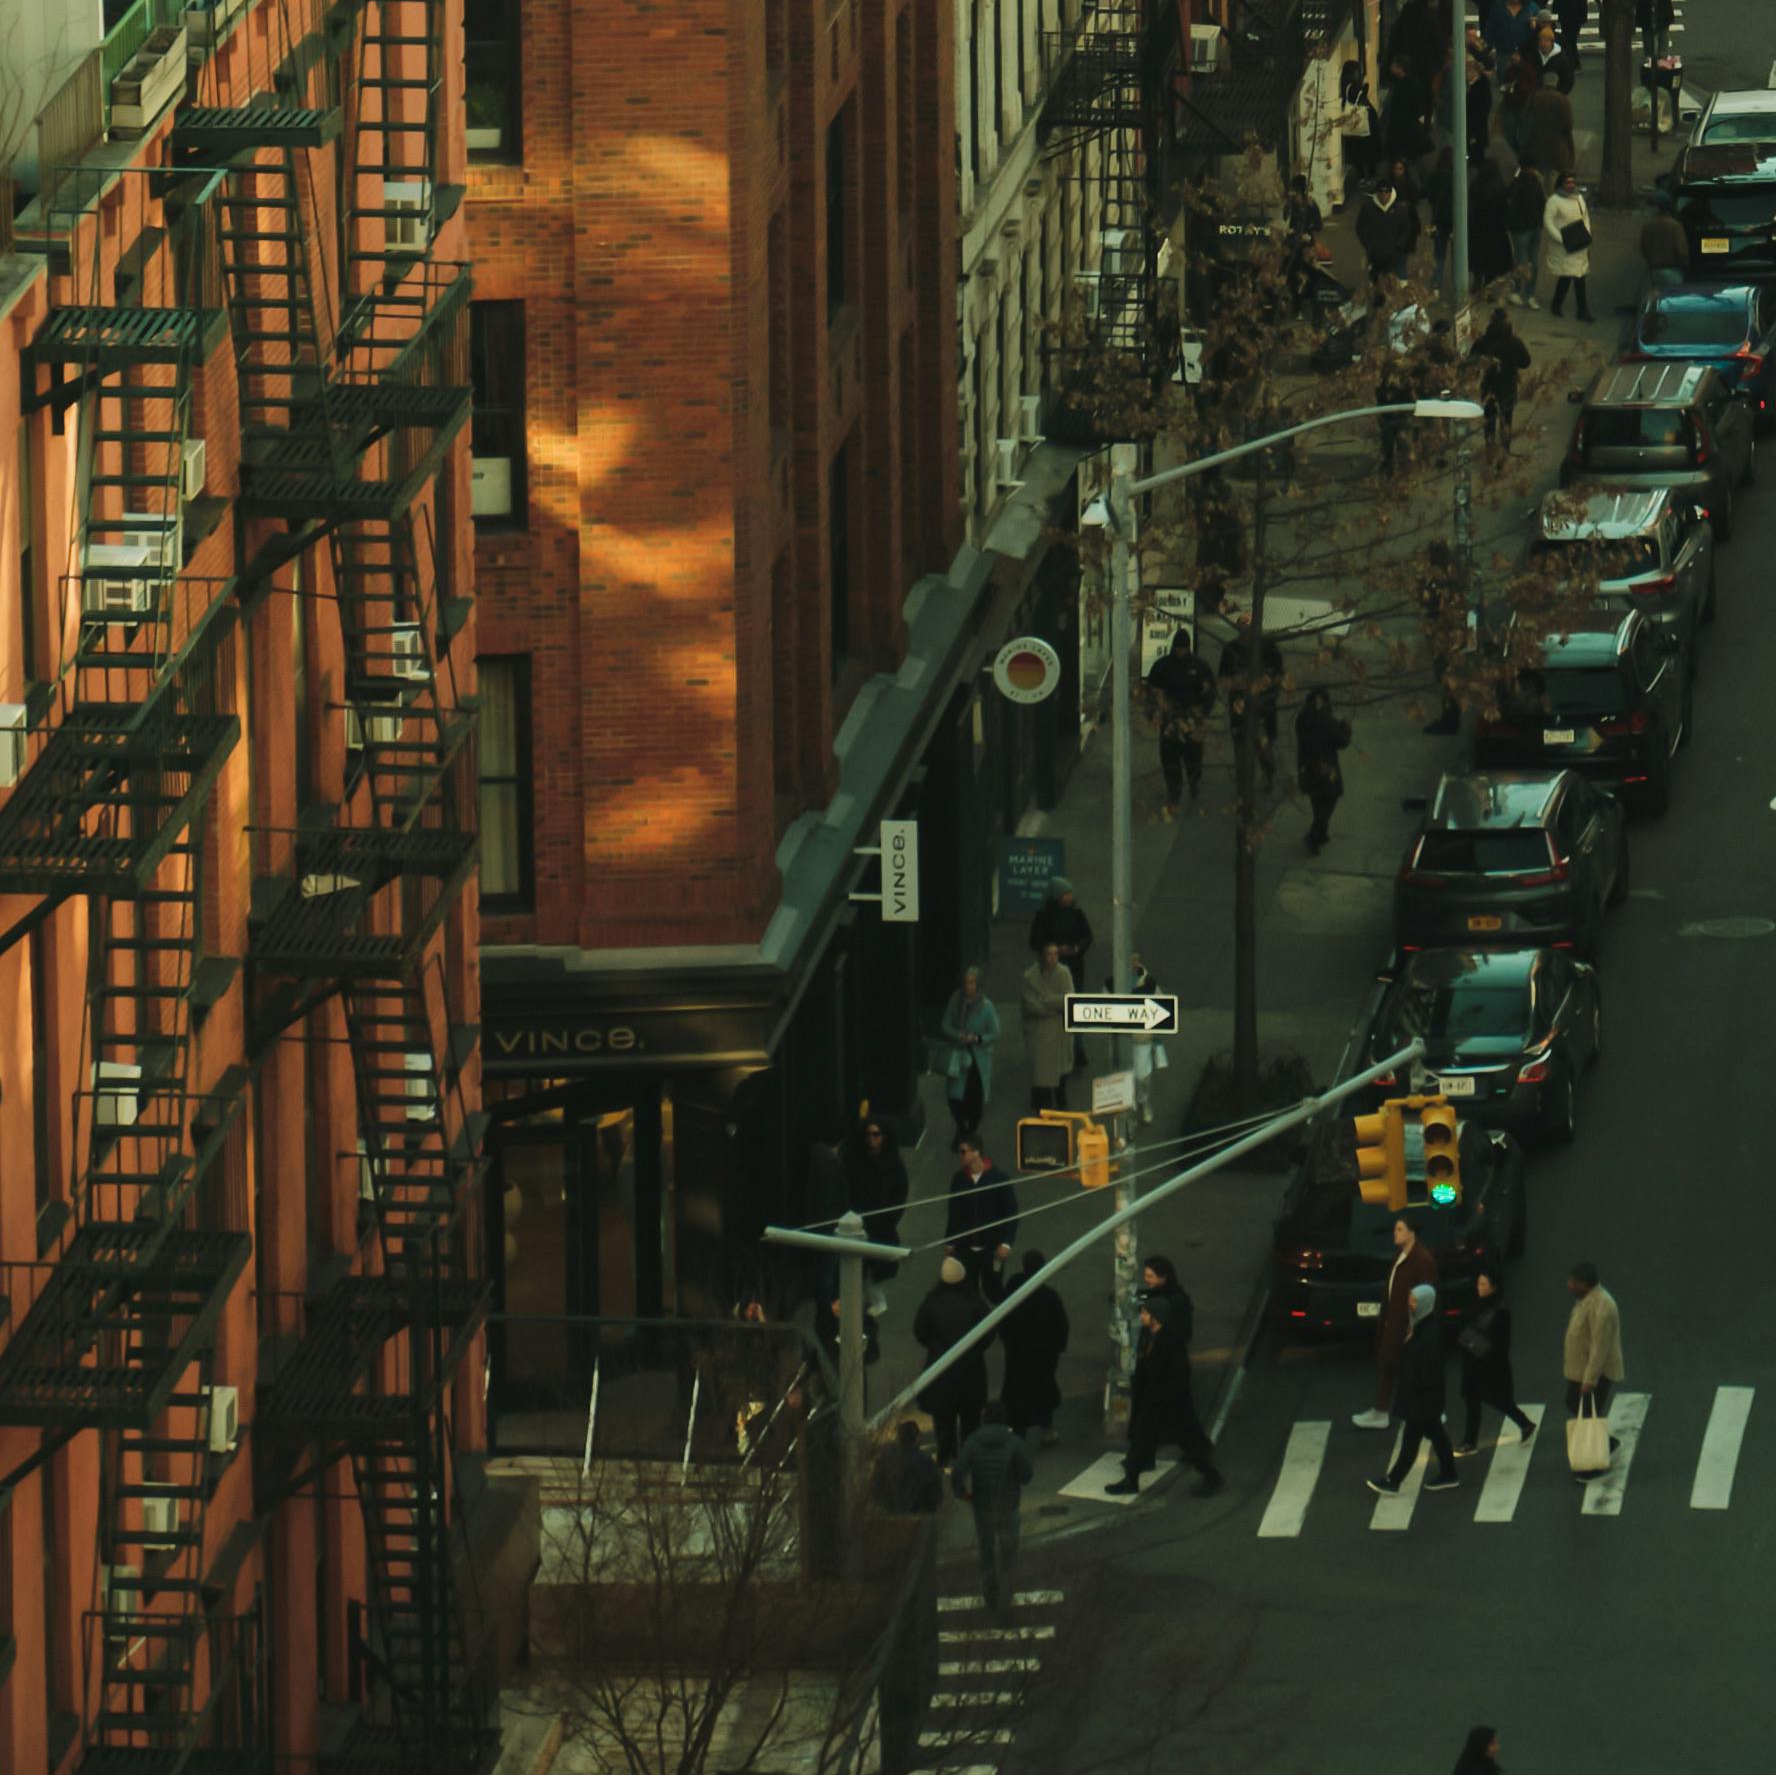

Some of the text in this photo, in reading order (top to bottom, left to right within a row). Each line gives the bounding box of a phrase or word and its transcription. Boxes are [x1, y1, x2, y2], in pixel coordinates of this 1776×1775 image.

[1219, 225, 1271, 236] ROTY'S
[1008, 854, 1054, 866] MARINE
[1012, 865, 1049, 874] LAYER
[1082, 1007, 1159, 1021] ONE WAY
